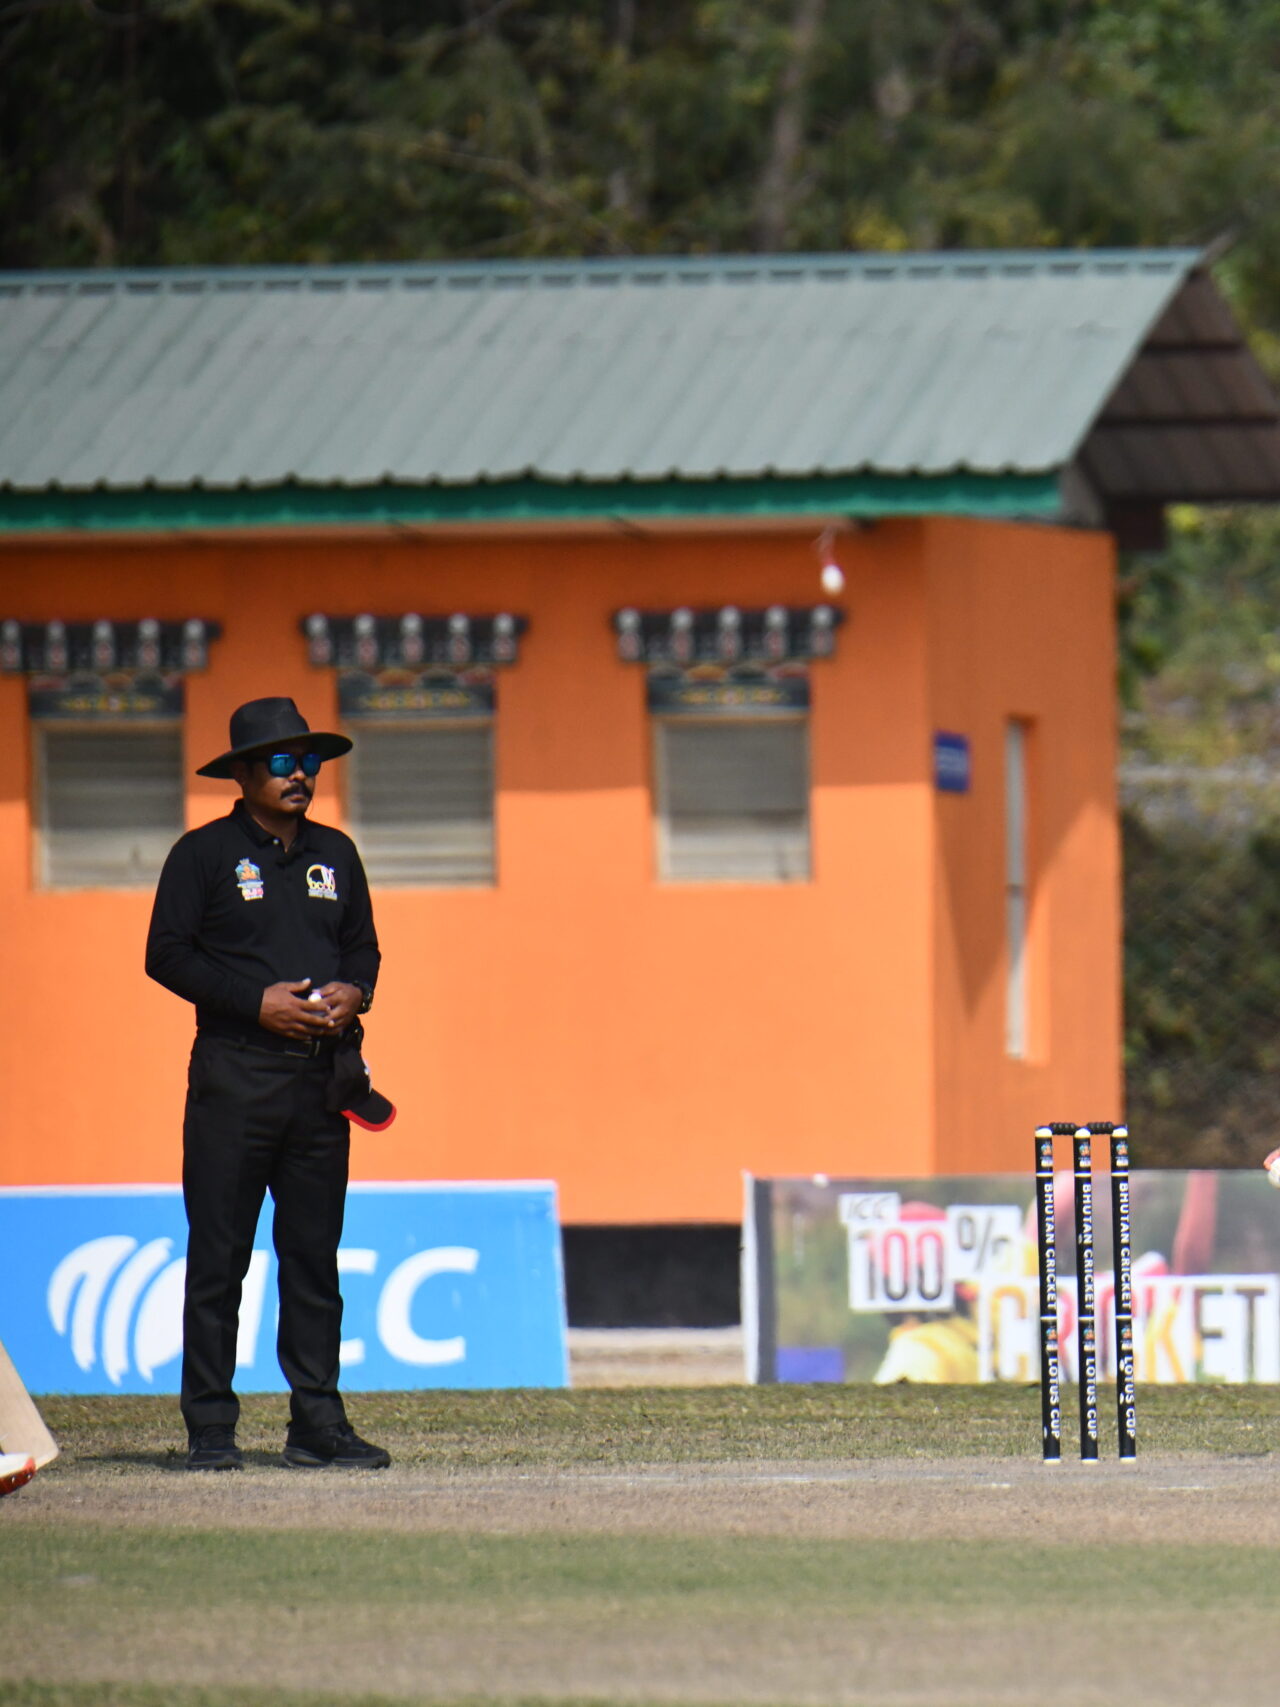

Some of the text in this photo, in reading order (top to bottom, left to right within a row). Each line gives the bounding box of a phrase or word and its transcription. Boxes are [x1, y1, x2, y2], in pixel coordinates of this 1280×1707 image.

[1043, 1183, 1057, 1309] BHUTAN CRICKET
[1082, 1184, 1094, 1310] BHUTAN CRICKET
[1119, 1182, 1132, 1308] BHUTAN CRICKET
[238, 1246, 479, 1365] IC
[991, 1284, 1267, 1382] CRCKET
[1048, 1357, 1059, 1405] LOTUS
[1085, 1357, 1096, 1405] LOTUS
[1124, 1355, 1134, 1404] LOTUS
[1050, 1408, 1060, 1439] CUP
[1087, 1408, 1097, 1440] CUP
[1126, 1406, 1136, 1438] CUP
